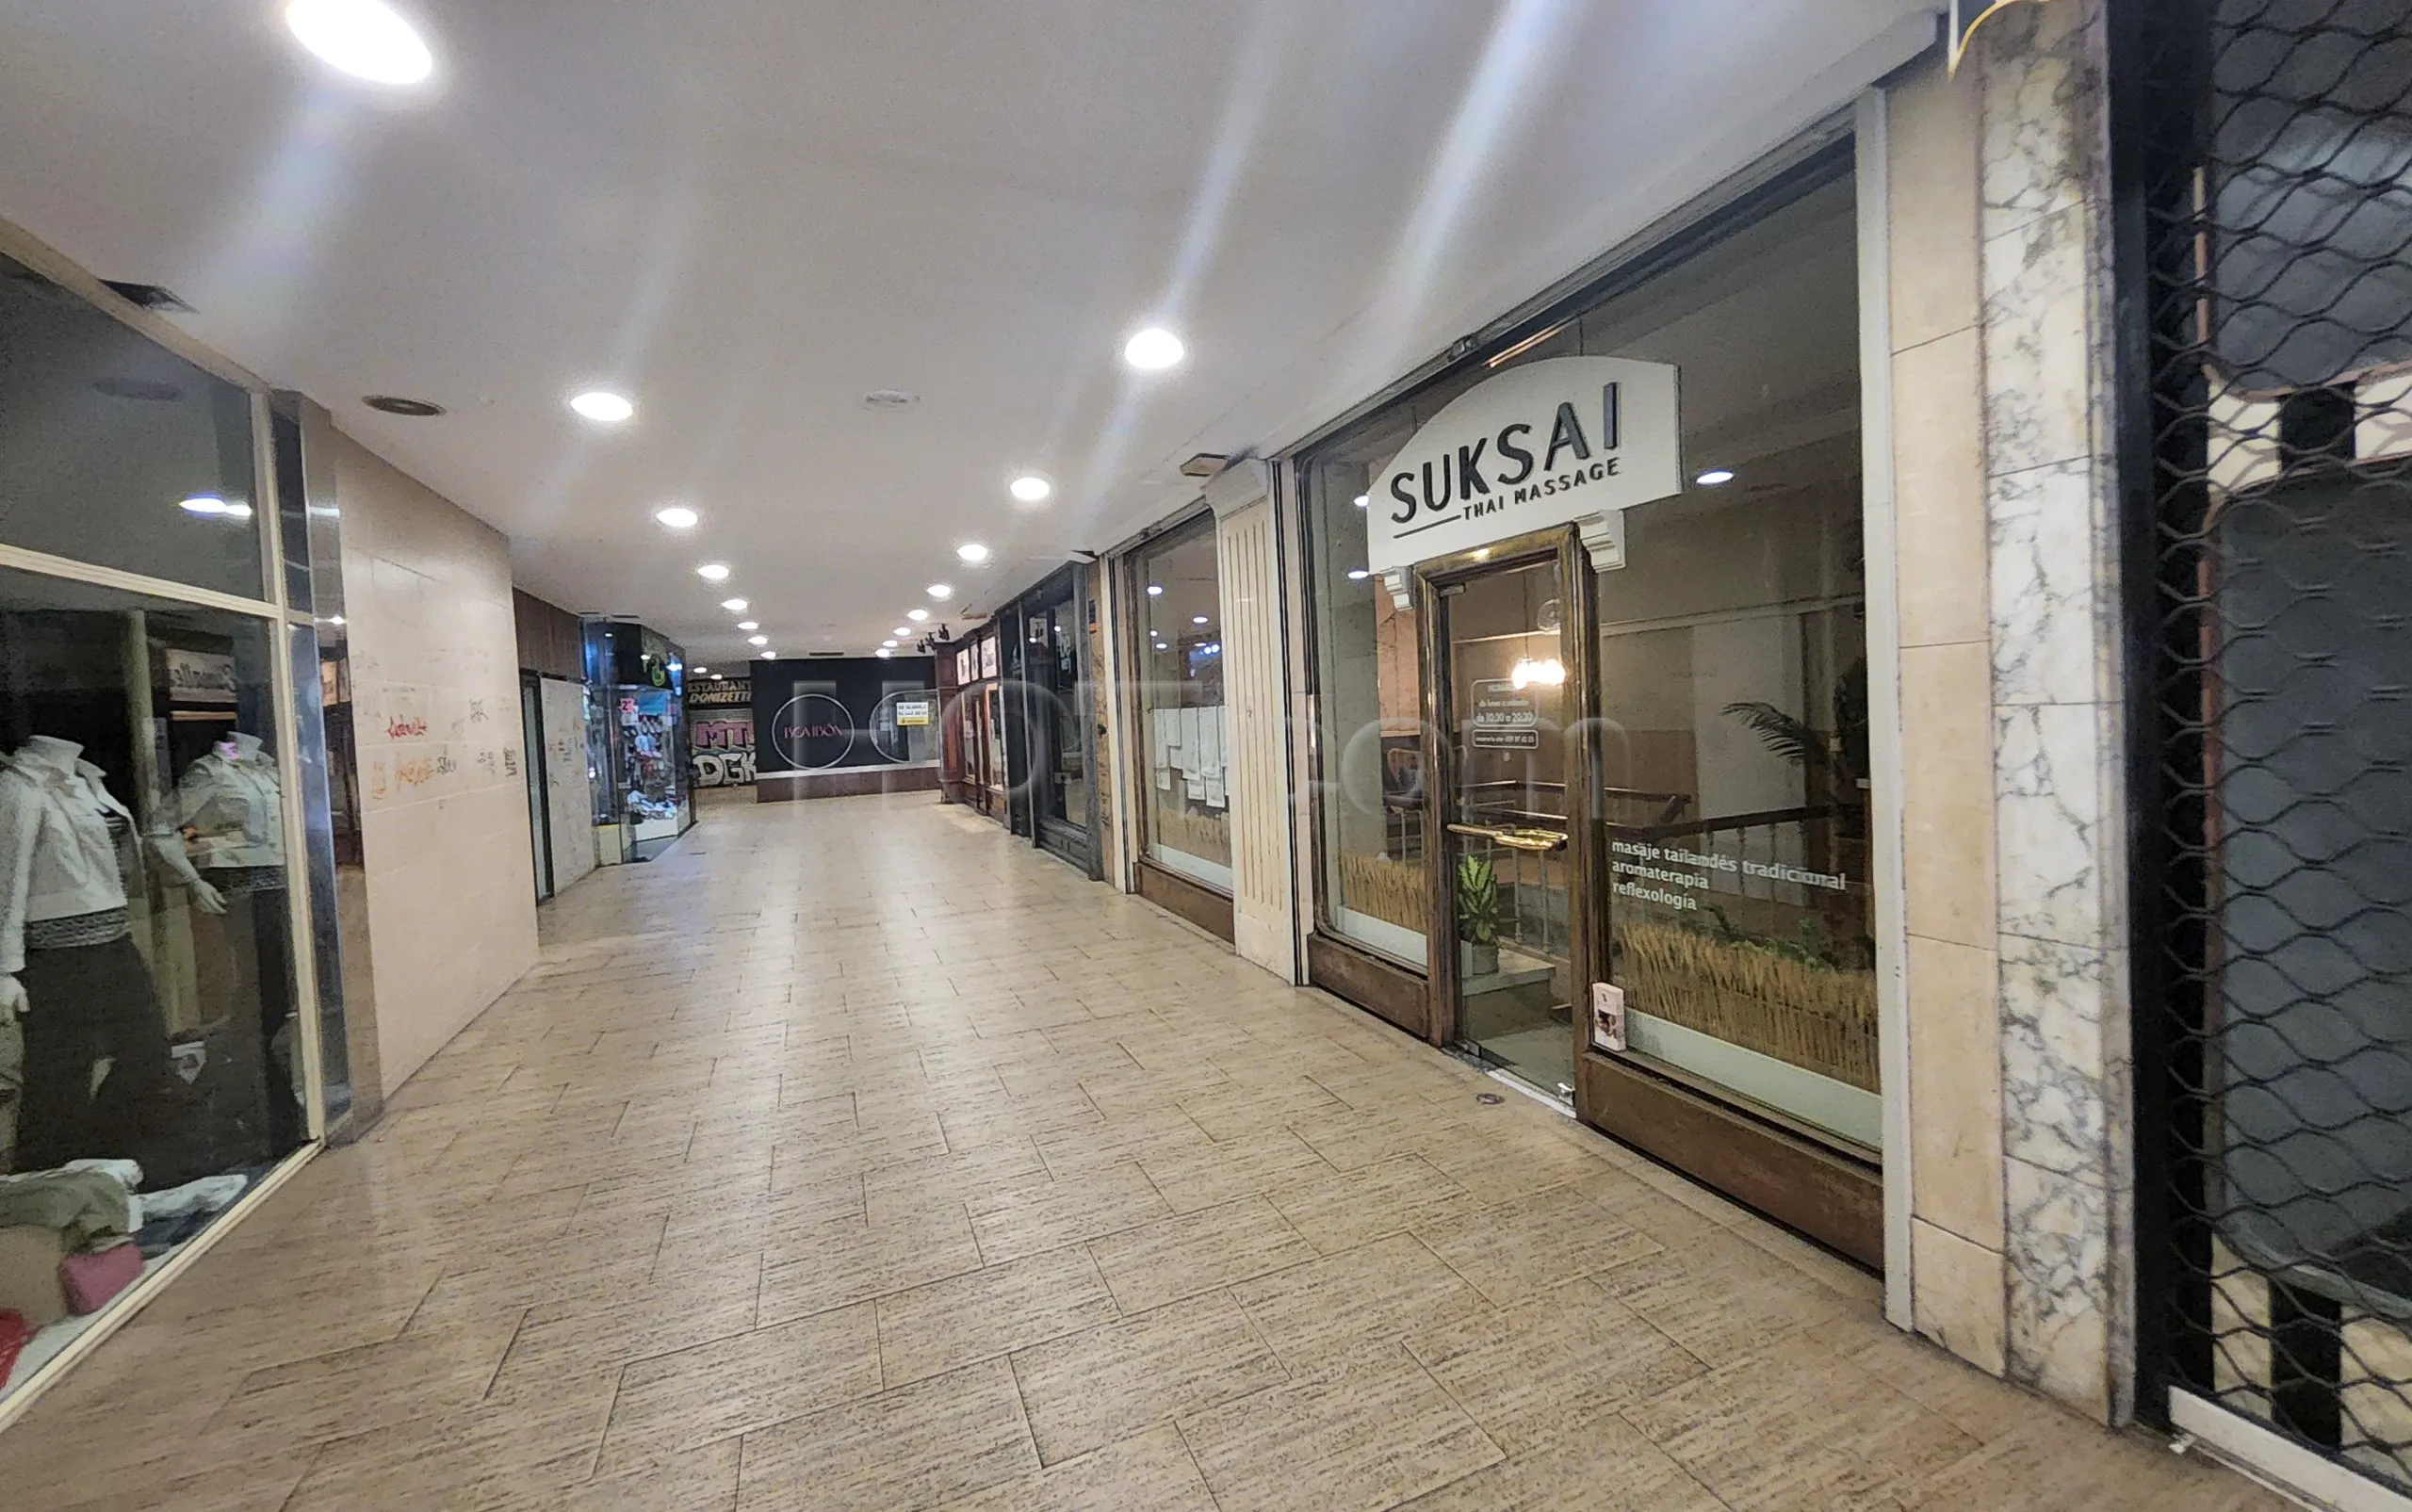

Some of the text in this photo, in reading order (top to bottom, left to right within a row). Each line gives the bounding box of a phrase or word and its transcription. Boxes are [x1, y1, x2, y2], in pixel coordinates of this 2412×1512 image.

[1390, 381, 1619, 525] SUKSAI
[1462, 457, 1622, 521] THAI MASSAGE
[687, 679, 751, 692] ESTAURANT
[1611, 839, 1660, 861] masaje
[1743, 859, 1847, 891] tradicional
[1611, 860, 1709, 890] aromaterapia
